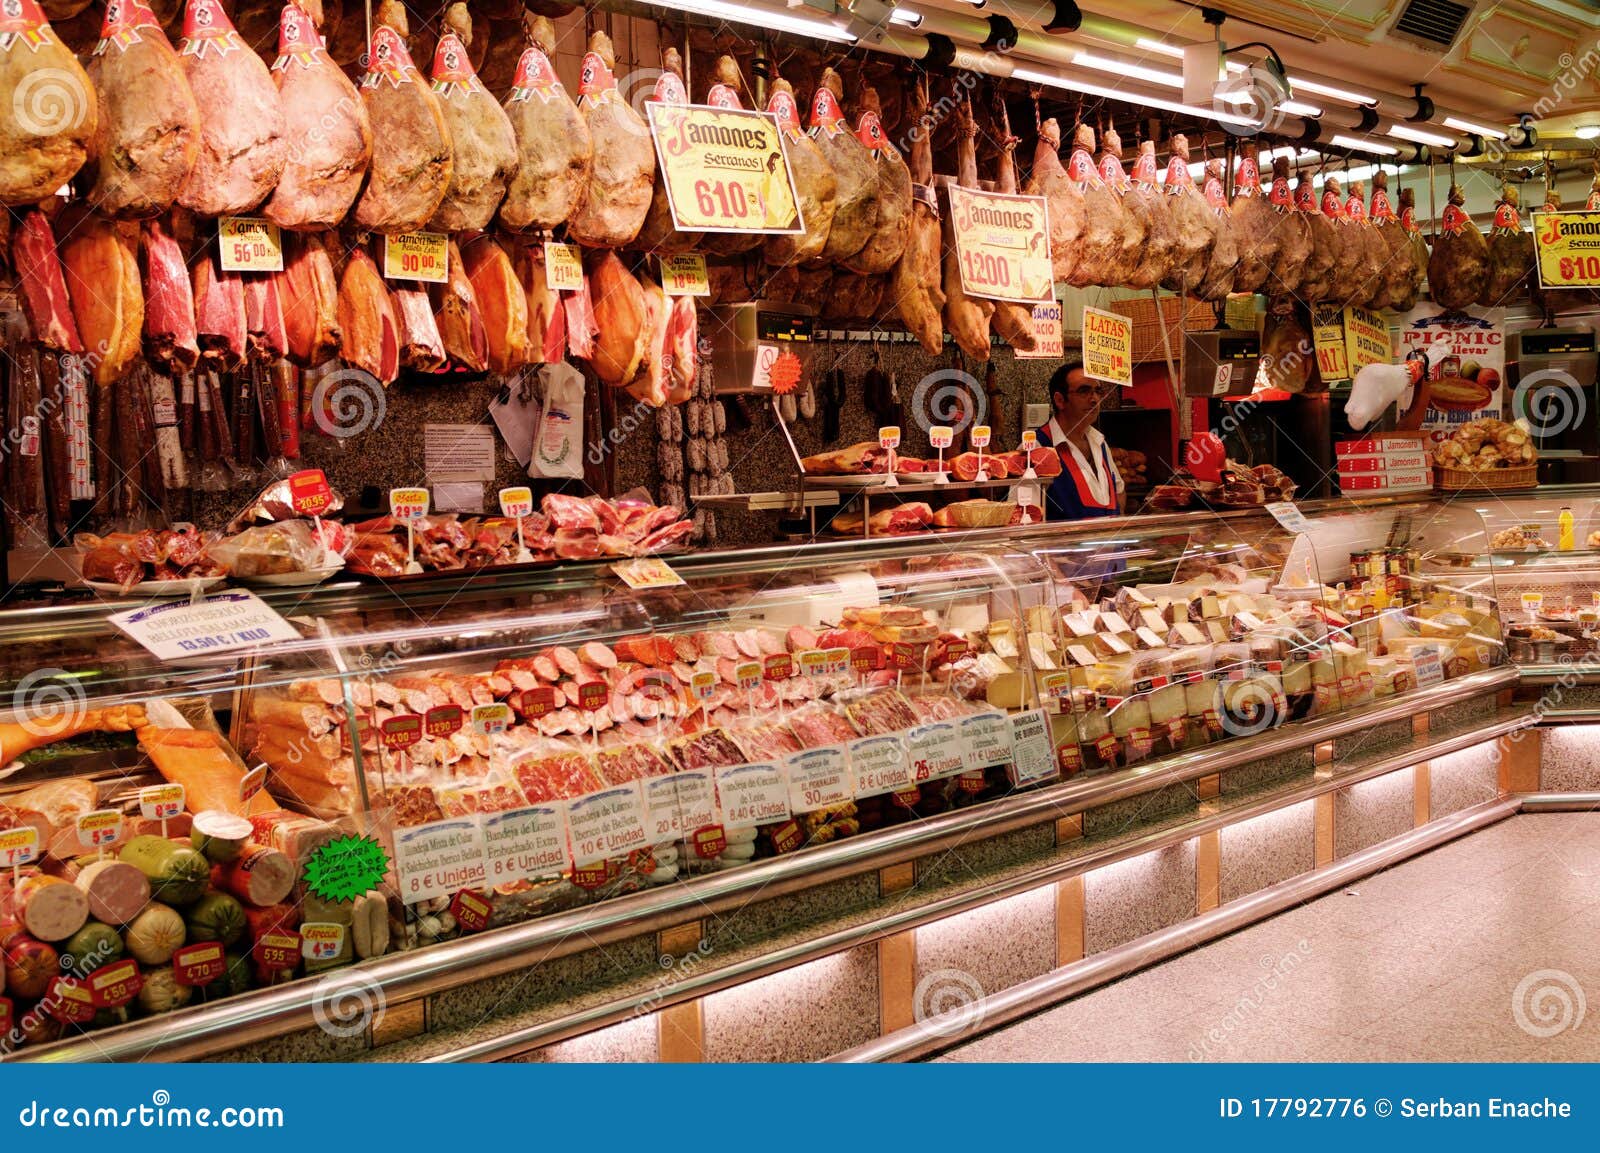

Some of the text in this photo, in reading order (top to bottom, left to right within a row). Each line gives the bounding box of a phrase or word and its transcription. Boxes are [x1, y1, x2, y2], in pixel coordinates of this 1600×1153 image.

[667, 112, 768, 156] Jamones
[704, 152, 759, 168] Serranos
[959, 194, 1034, 232] Jamones
[1090, 316, 1125, 338] LATAS
[1403, 331, 1502, 346] PICNIC
[1451, 345, 1488, 354] llevar
[876, 768, 908, 786] Unidad
[757, 801, 785, 816] Unidad
[581, 840, 594, 856] 10
[606, 825, 645, 848] Unidad
[494, 860, 503, 874] 8
[518, 847, 563, 869] Unidad
[411, 878, 420, 892] 8
[436, 863, 485, 886] Unidad
